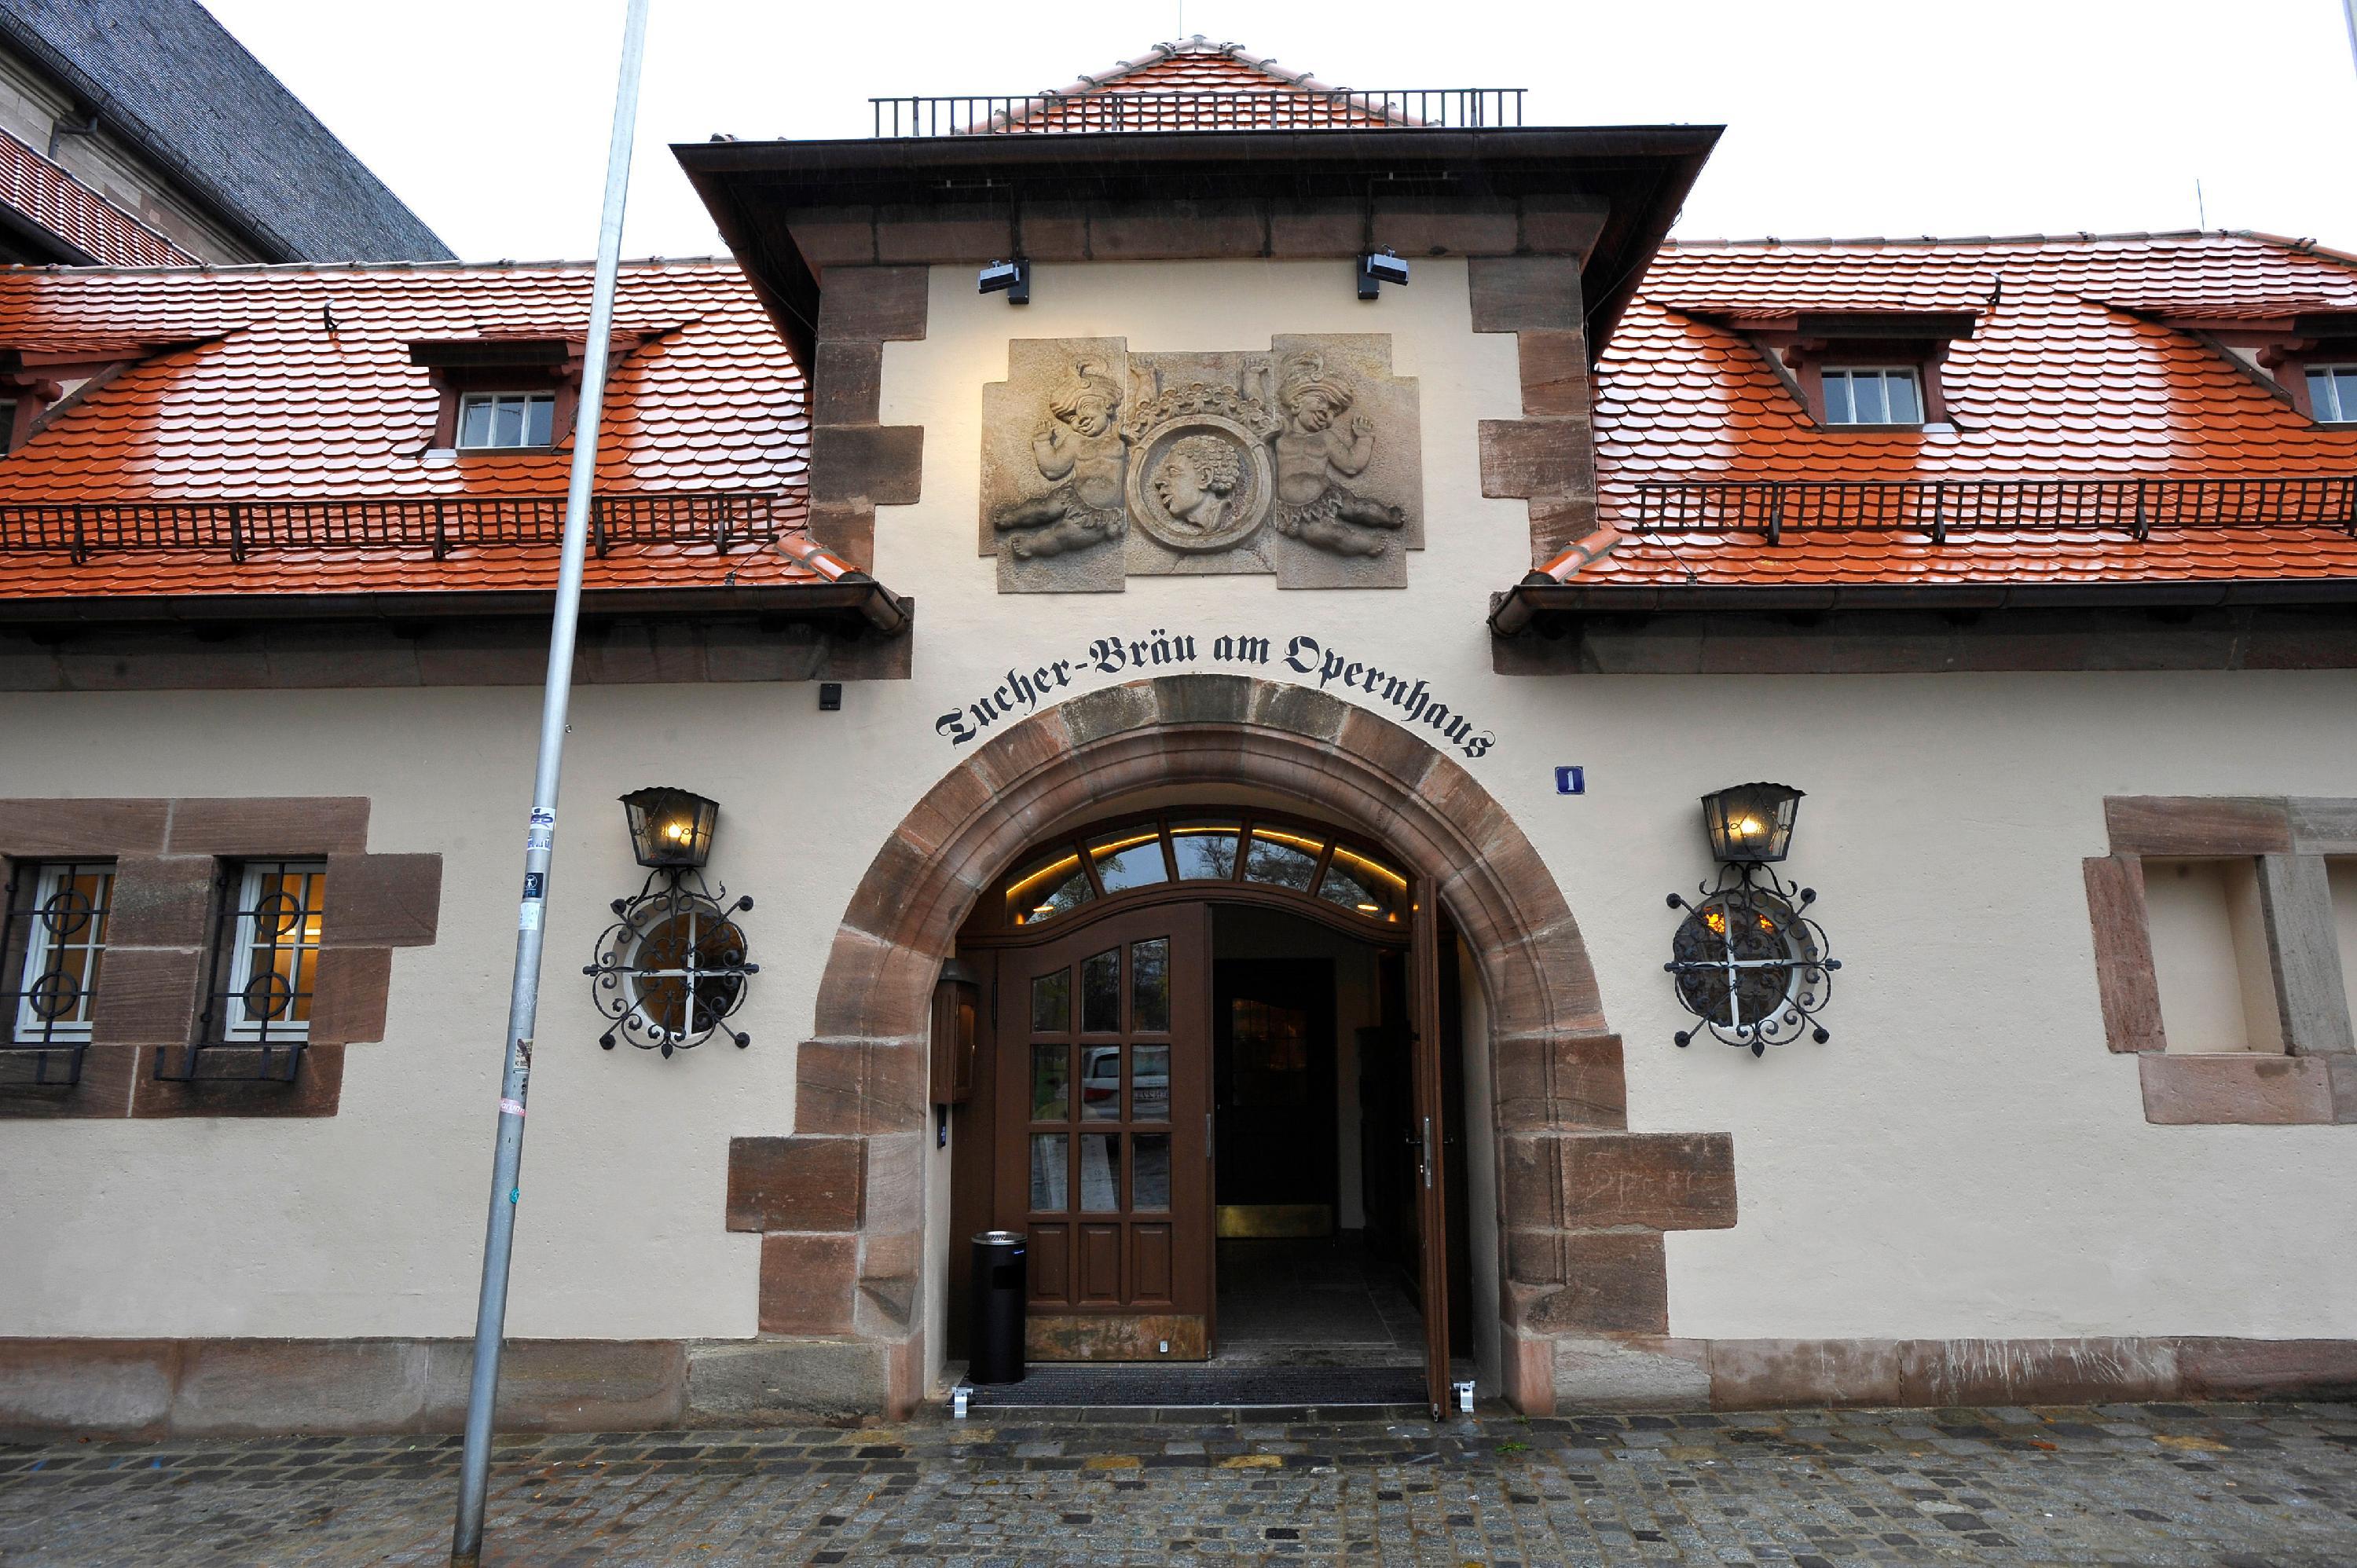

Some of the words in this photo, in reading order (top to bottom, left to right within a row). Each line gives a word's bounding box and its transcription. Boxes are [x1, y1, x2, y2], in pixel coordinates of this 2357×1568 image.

[935, 628, 1197, 749] Tucher-Bräu
[1213, 635, 1270, 665] am
[1281, 636, 1496, 758] Opernhaus
[1567, 771, 1575, 791] 1
